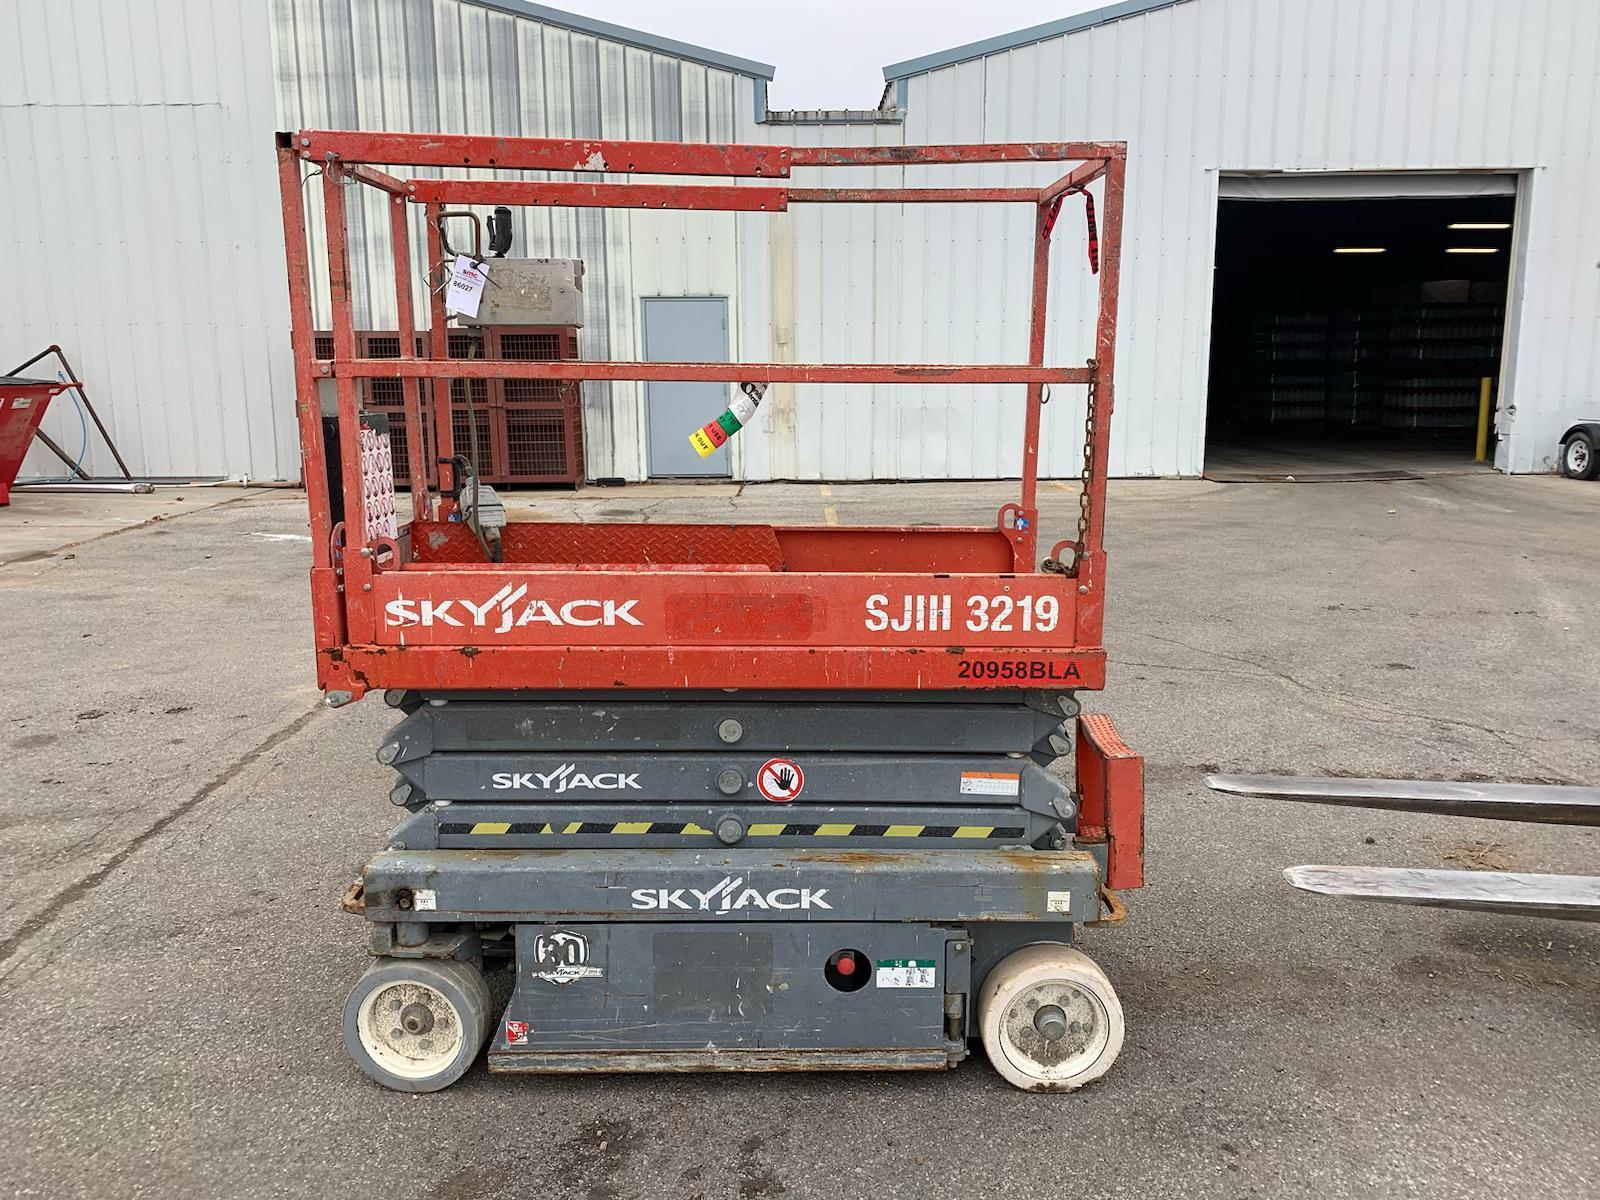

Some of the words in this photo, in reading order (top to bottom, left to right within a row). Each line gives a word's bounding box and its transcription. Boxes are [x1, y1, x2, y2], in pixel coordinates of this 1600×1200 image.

[385, 581, 643, 634] SKYJACK
[965, 595, 1060, 632] 3219
[957, 660, 1081, 680] 20958BLA
[491, 763, 643, 793] SKYJACK
[630, 876, 834, 915] SKYJACK
